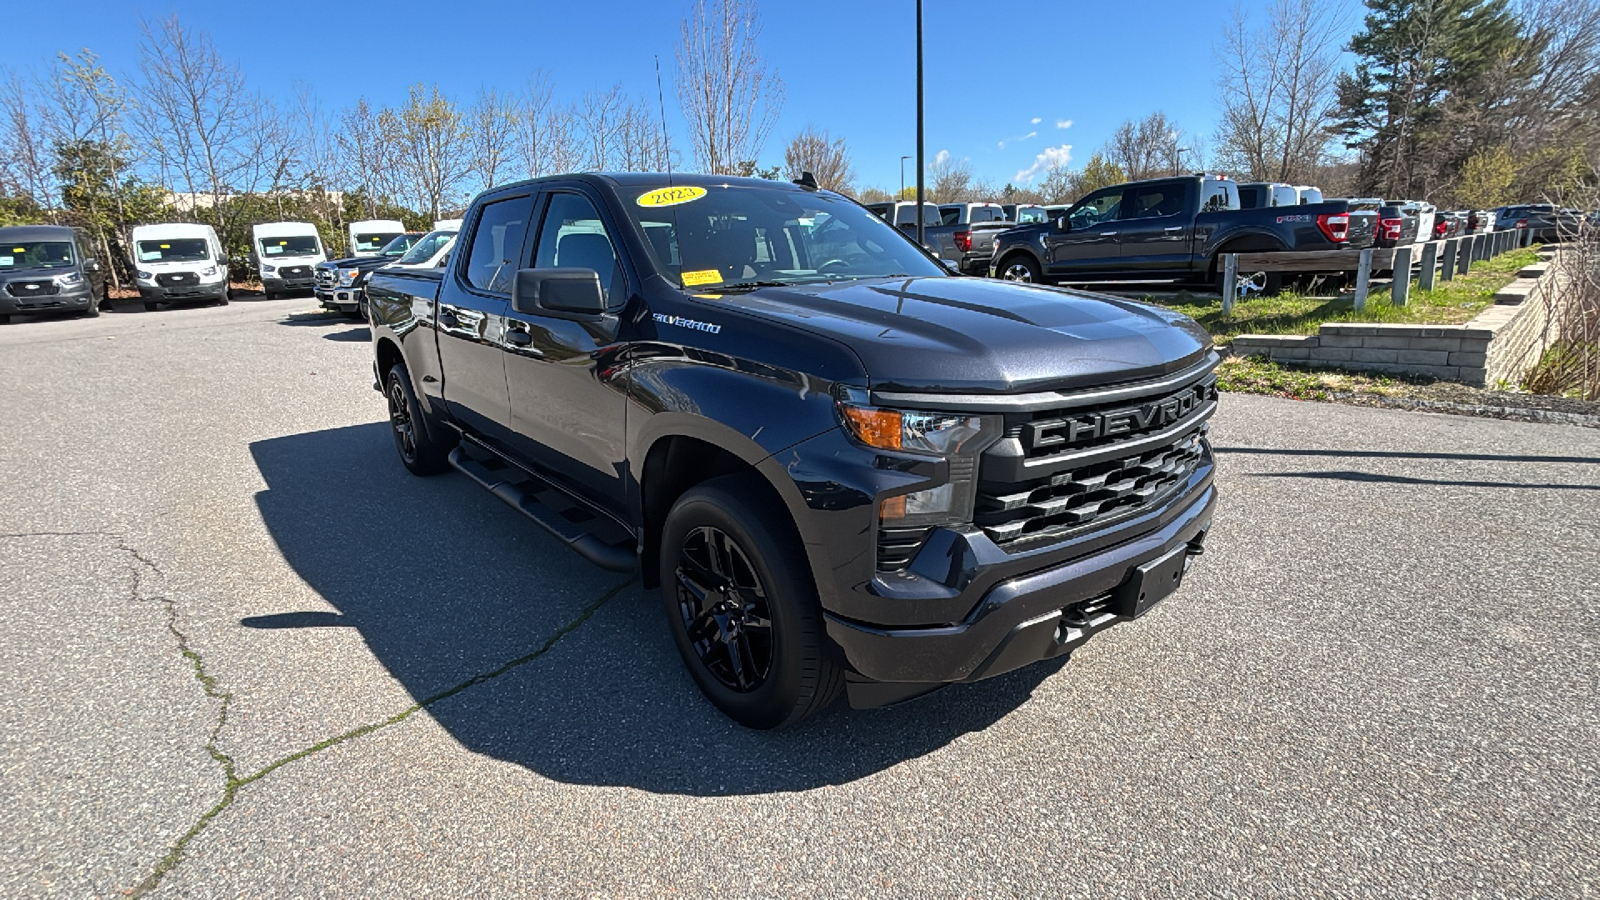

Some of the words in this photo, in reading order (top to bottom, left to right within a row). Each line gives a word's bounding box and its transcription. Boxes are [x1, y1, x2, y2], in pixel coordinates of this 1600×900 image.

[651, 188, 695, 204] 2023
[652, 313, 721, 334] SILVERADO
[1033, 376, 1217, 448] CHEVROLE
